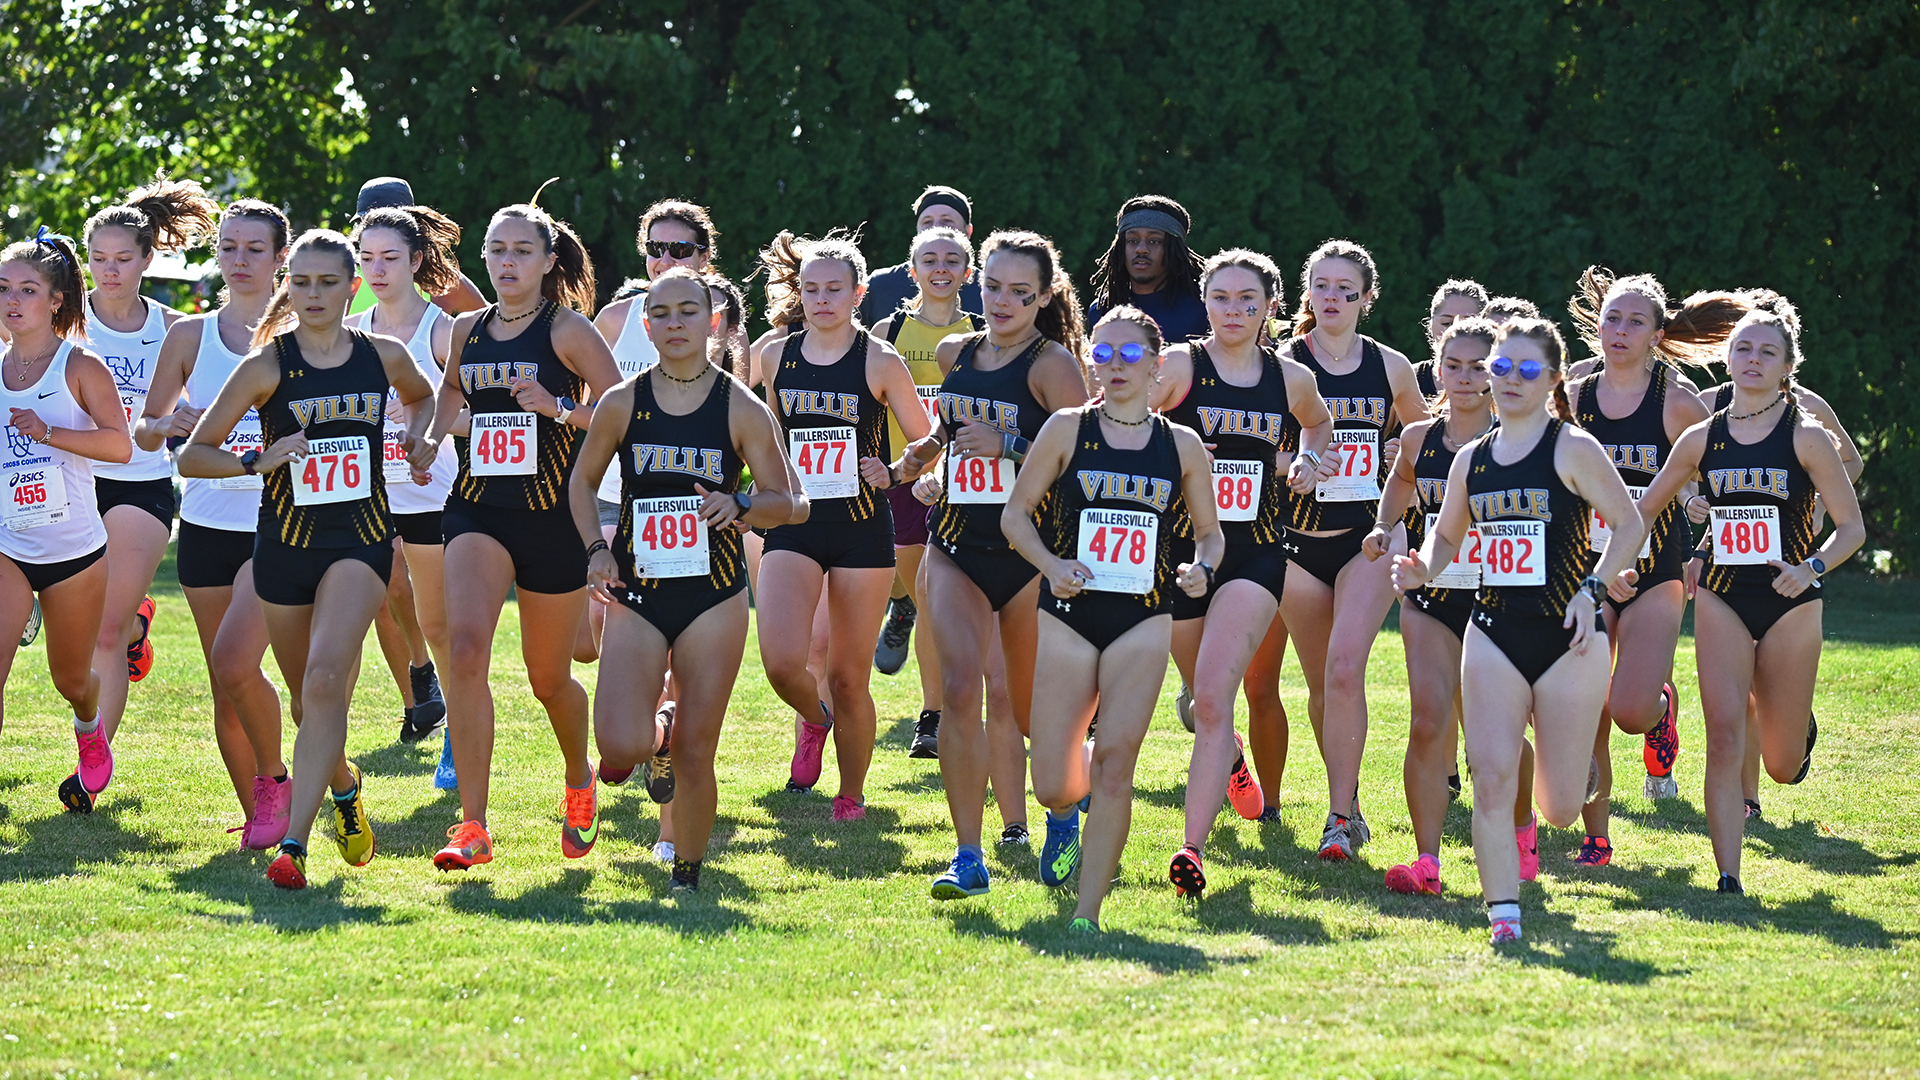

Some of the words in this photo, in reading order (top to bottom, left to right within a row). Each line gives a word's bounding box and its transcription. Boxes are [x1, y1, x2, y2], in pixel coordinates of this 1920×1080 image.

[118, 386, 148, 395] COUNTR
[459, 362, 538, 395] VILLE
[288, 393, 382, 429] VILLE
[475, 415, 532, 428] MILLERSVILLE
[779, 389, 860, 425] VILLE
[938, 392, 1020, 436] VILLE
[1324, 397, 1385, 428] ILLE
[793, 429, 852, 442] MILLERSVILLE
[1197, 406, 1283, 446] VILLE
[2, 460, 20, 469] CROSS
[21, 456, 52, 466] COUNTRY
[384, 442, 406, 461] 56
[477, 429, 526, 464] 485
[798, 441, 847, 475] 477
[1601, 445, 1659, 475] LLE
[302, 453, 360, 493] 476
[631, 444, 724, 484] VILLE
[954, 457, 1003, 493] 481
[13, 483, 47, 506] 455
[1077, 469, 1172, 513] VILLE
[1216, 476, 1253, 510] 88
[1707, 467, 1790, 500] VILLE
[638, 499, 702, 514] MILLERSVILLE
[1086, 511, 1154, 528] MILLERSVILLE
[1469, 488, 1552, 522] VILLE
[1715, 508, 1774, 520] MILLERSVILLE
[642, 513, 698, 551] 489
[1089, 526, 1146, 565] 478
[1481, 524, 1539, 537] MILLERSVILLE
[1720, 521, 1770, 555] 480
[1486, 538, 1534, 574] 482
